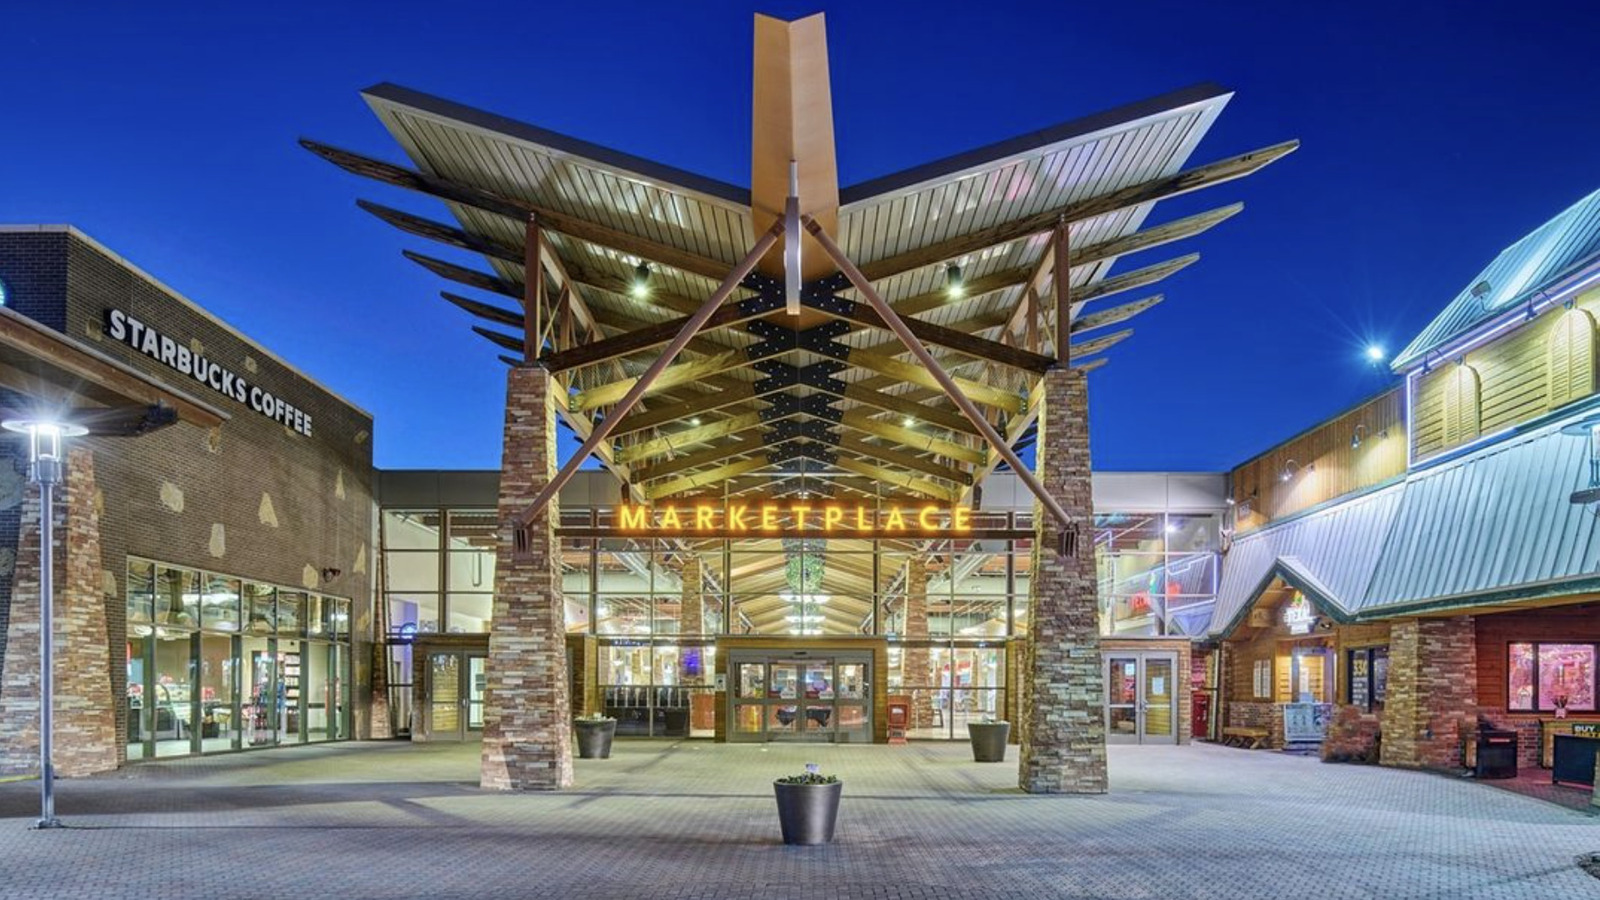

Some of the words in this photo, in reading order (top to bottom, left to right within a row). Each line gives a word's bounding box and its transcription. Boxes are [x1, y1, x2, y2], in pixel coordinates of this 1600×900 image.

[110, 309, 247, 404] STARBUCKS
[251, 386, 312, 438] COFFEE
[619, 505, 972, 531] MARKETPLACE
[1574, 725, 1596, 733] BUY
